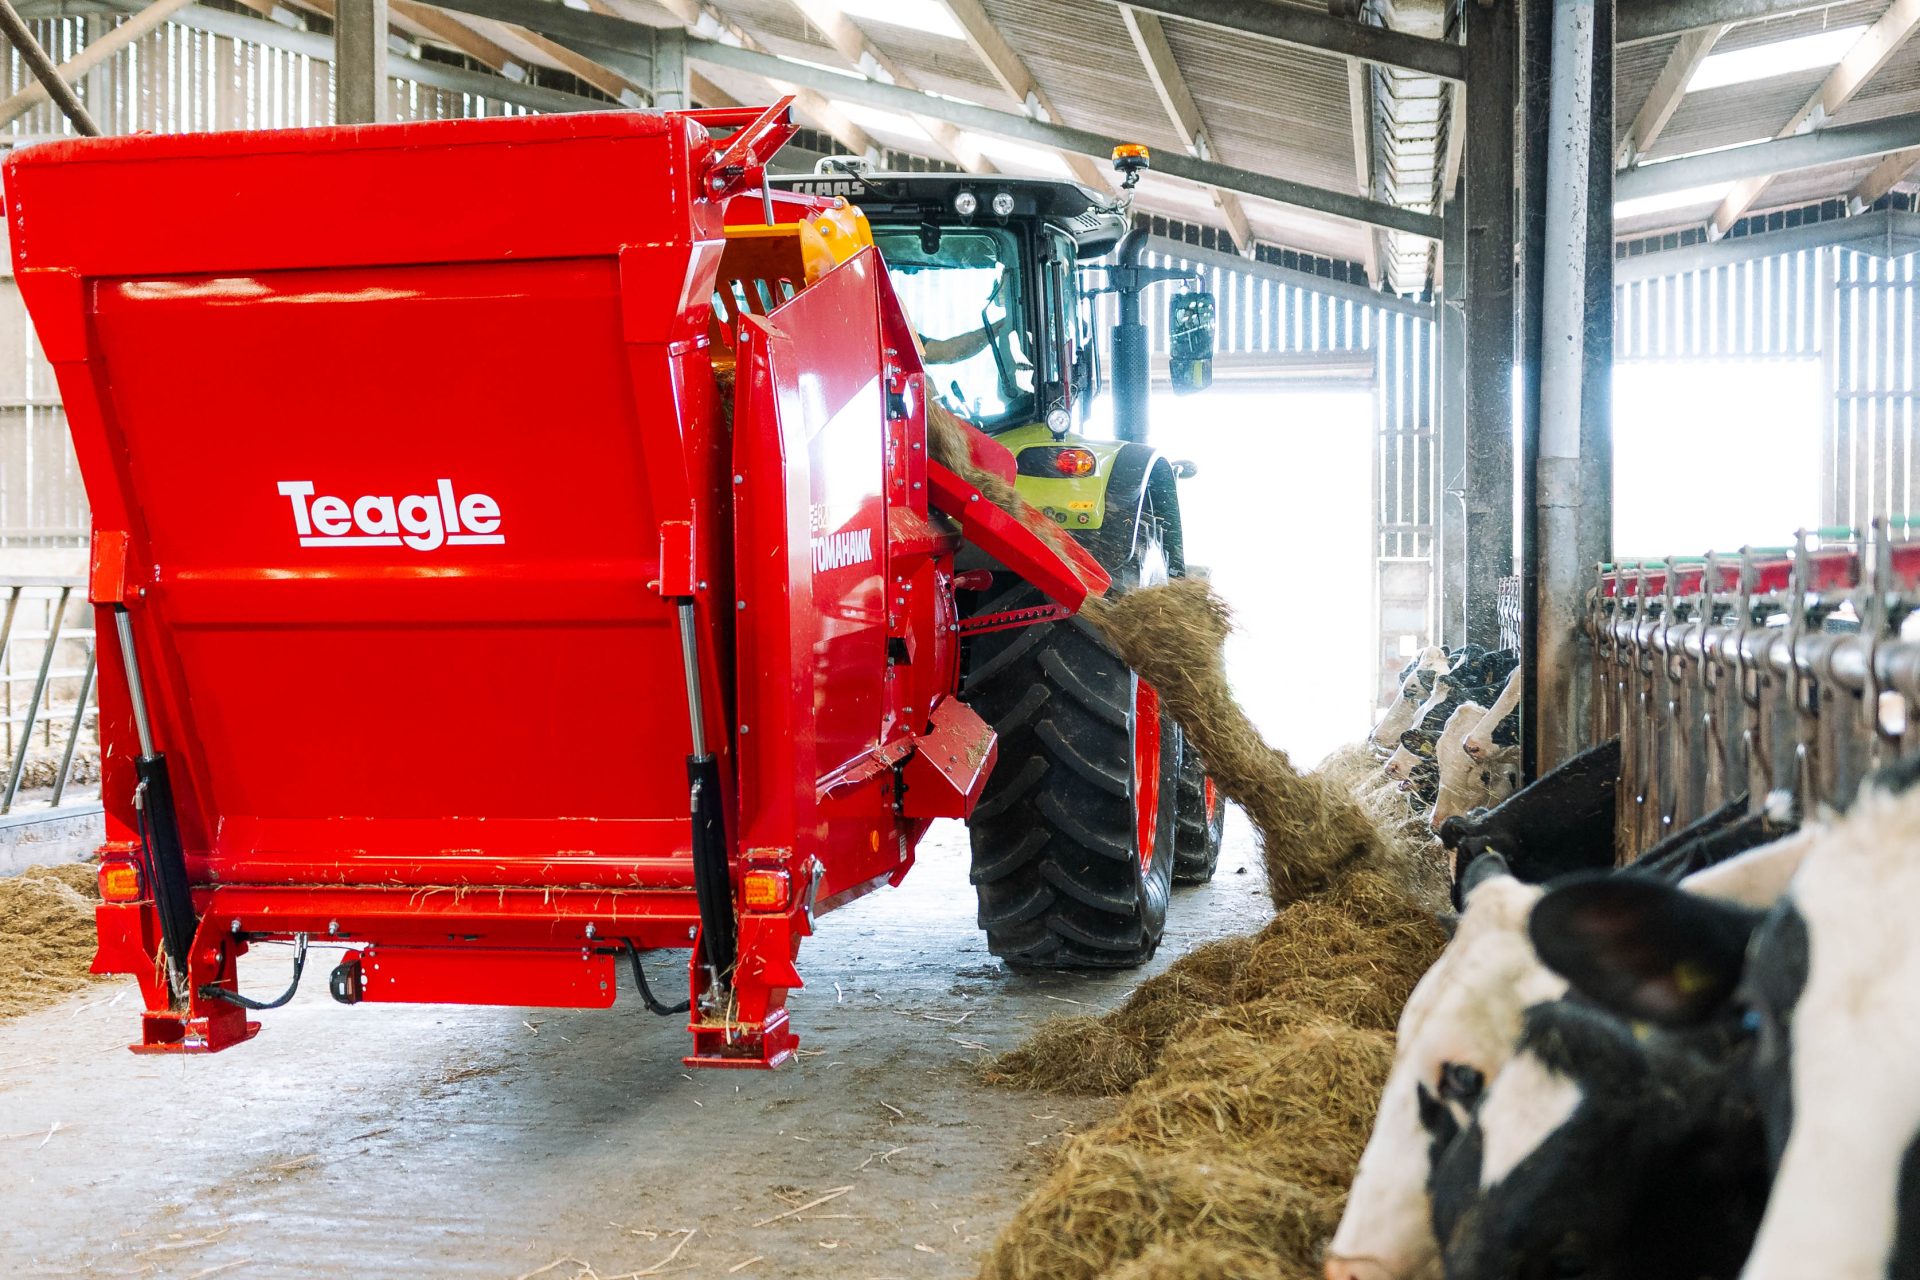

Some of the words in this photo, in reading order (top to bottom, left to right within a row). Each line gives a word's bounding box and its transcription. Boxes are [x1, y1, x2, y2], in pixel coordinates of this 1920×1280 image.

[792, 181, 865, 196] CLAAS
[277, 478, 503, 552] Teagle
[810, 528, 872, 574] TOMAHAWK
